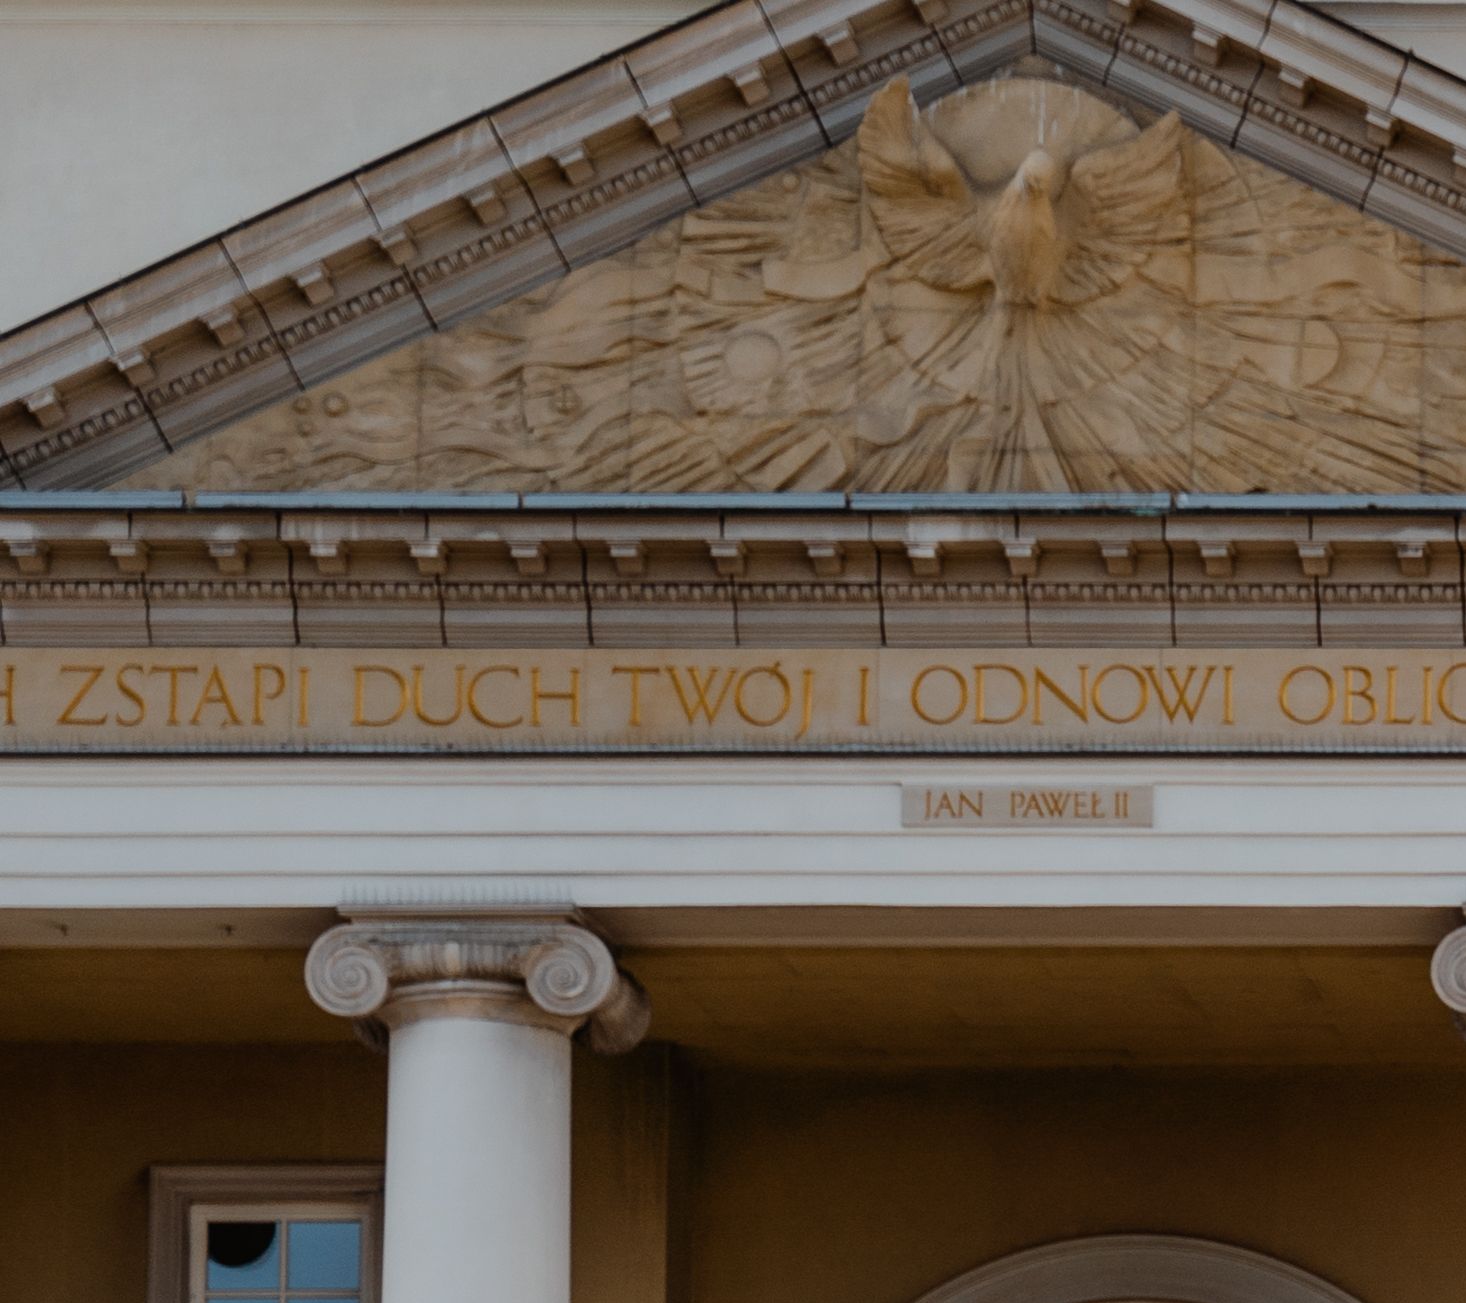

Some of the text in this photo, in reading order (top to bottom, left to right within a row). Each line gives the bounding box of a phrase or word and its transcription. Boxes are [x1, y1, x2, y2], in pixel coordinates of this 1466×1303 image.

[351, 662, 582, 728] DUCH
[611, 661, 816, 740] TWÓJ
[856, 665, 872, 727] I
[910, 662, 1236, 726] ODNOWI
[923, 789, 1129, 820] JAN PAWEŁ II
